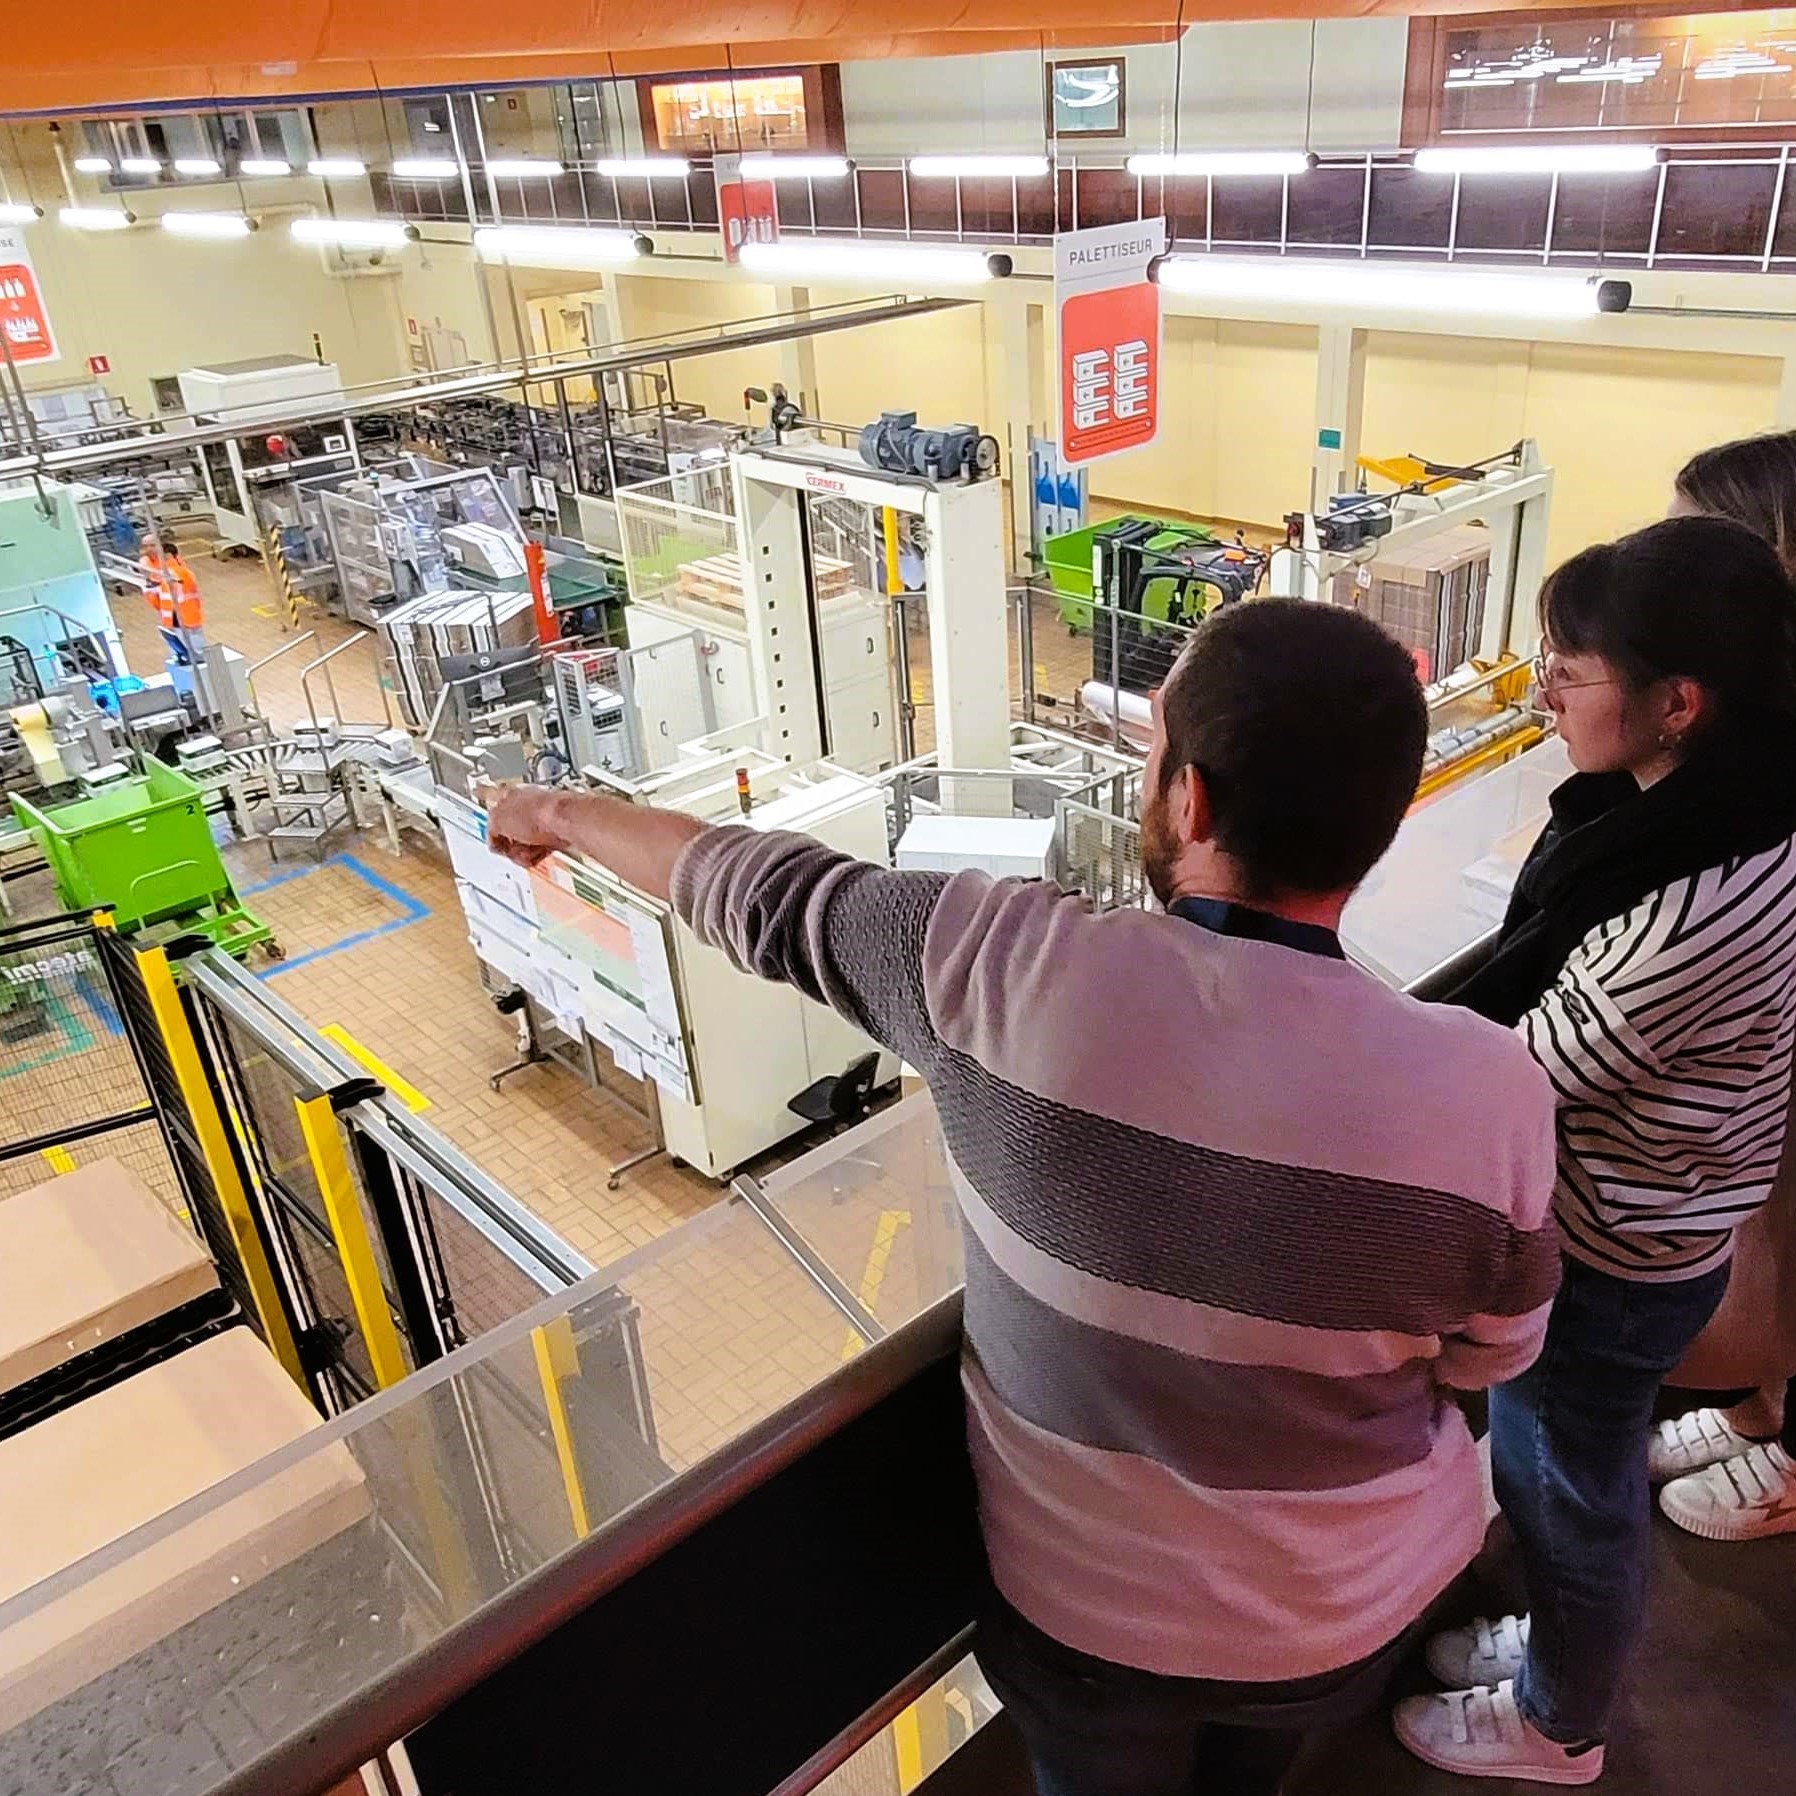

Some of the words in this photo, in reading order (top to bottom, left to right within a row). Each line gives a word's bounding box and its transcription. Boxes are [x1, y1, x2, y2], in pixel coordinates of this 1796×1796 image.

[1069, 239, 1152, 265] PALETTISEUR
[806, 476, 845, 491] CERMEX
[185, 804, 195, 815] 2
